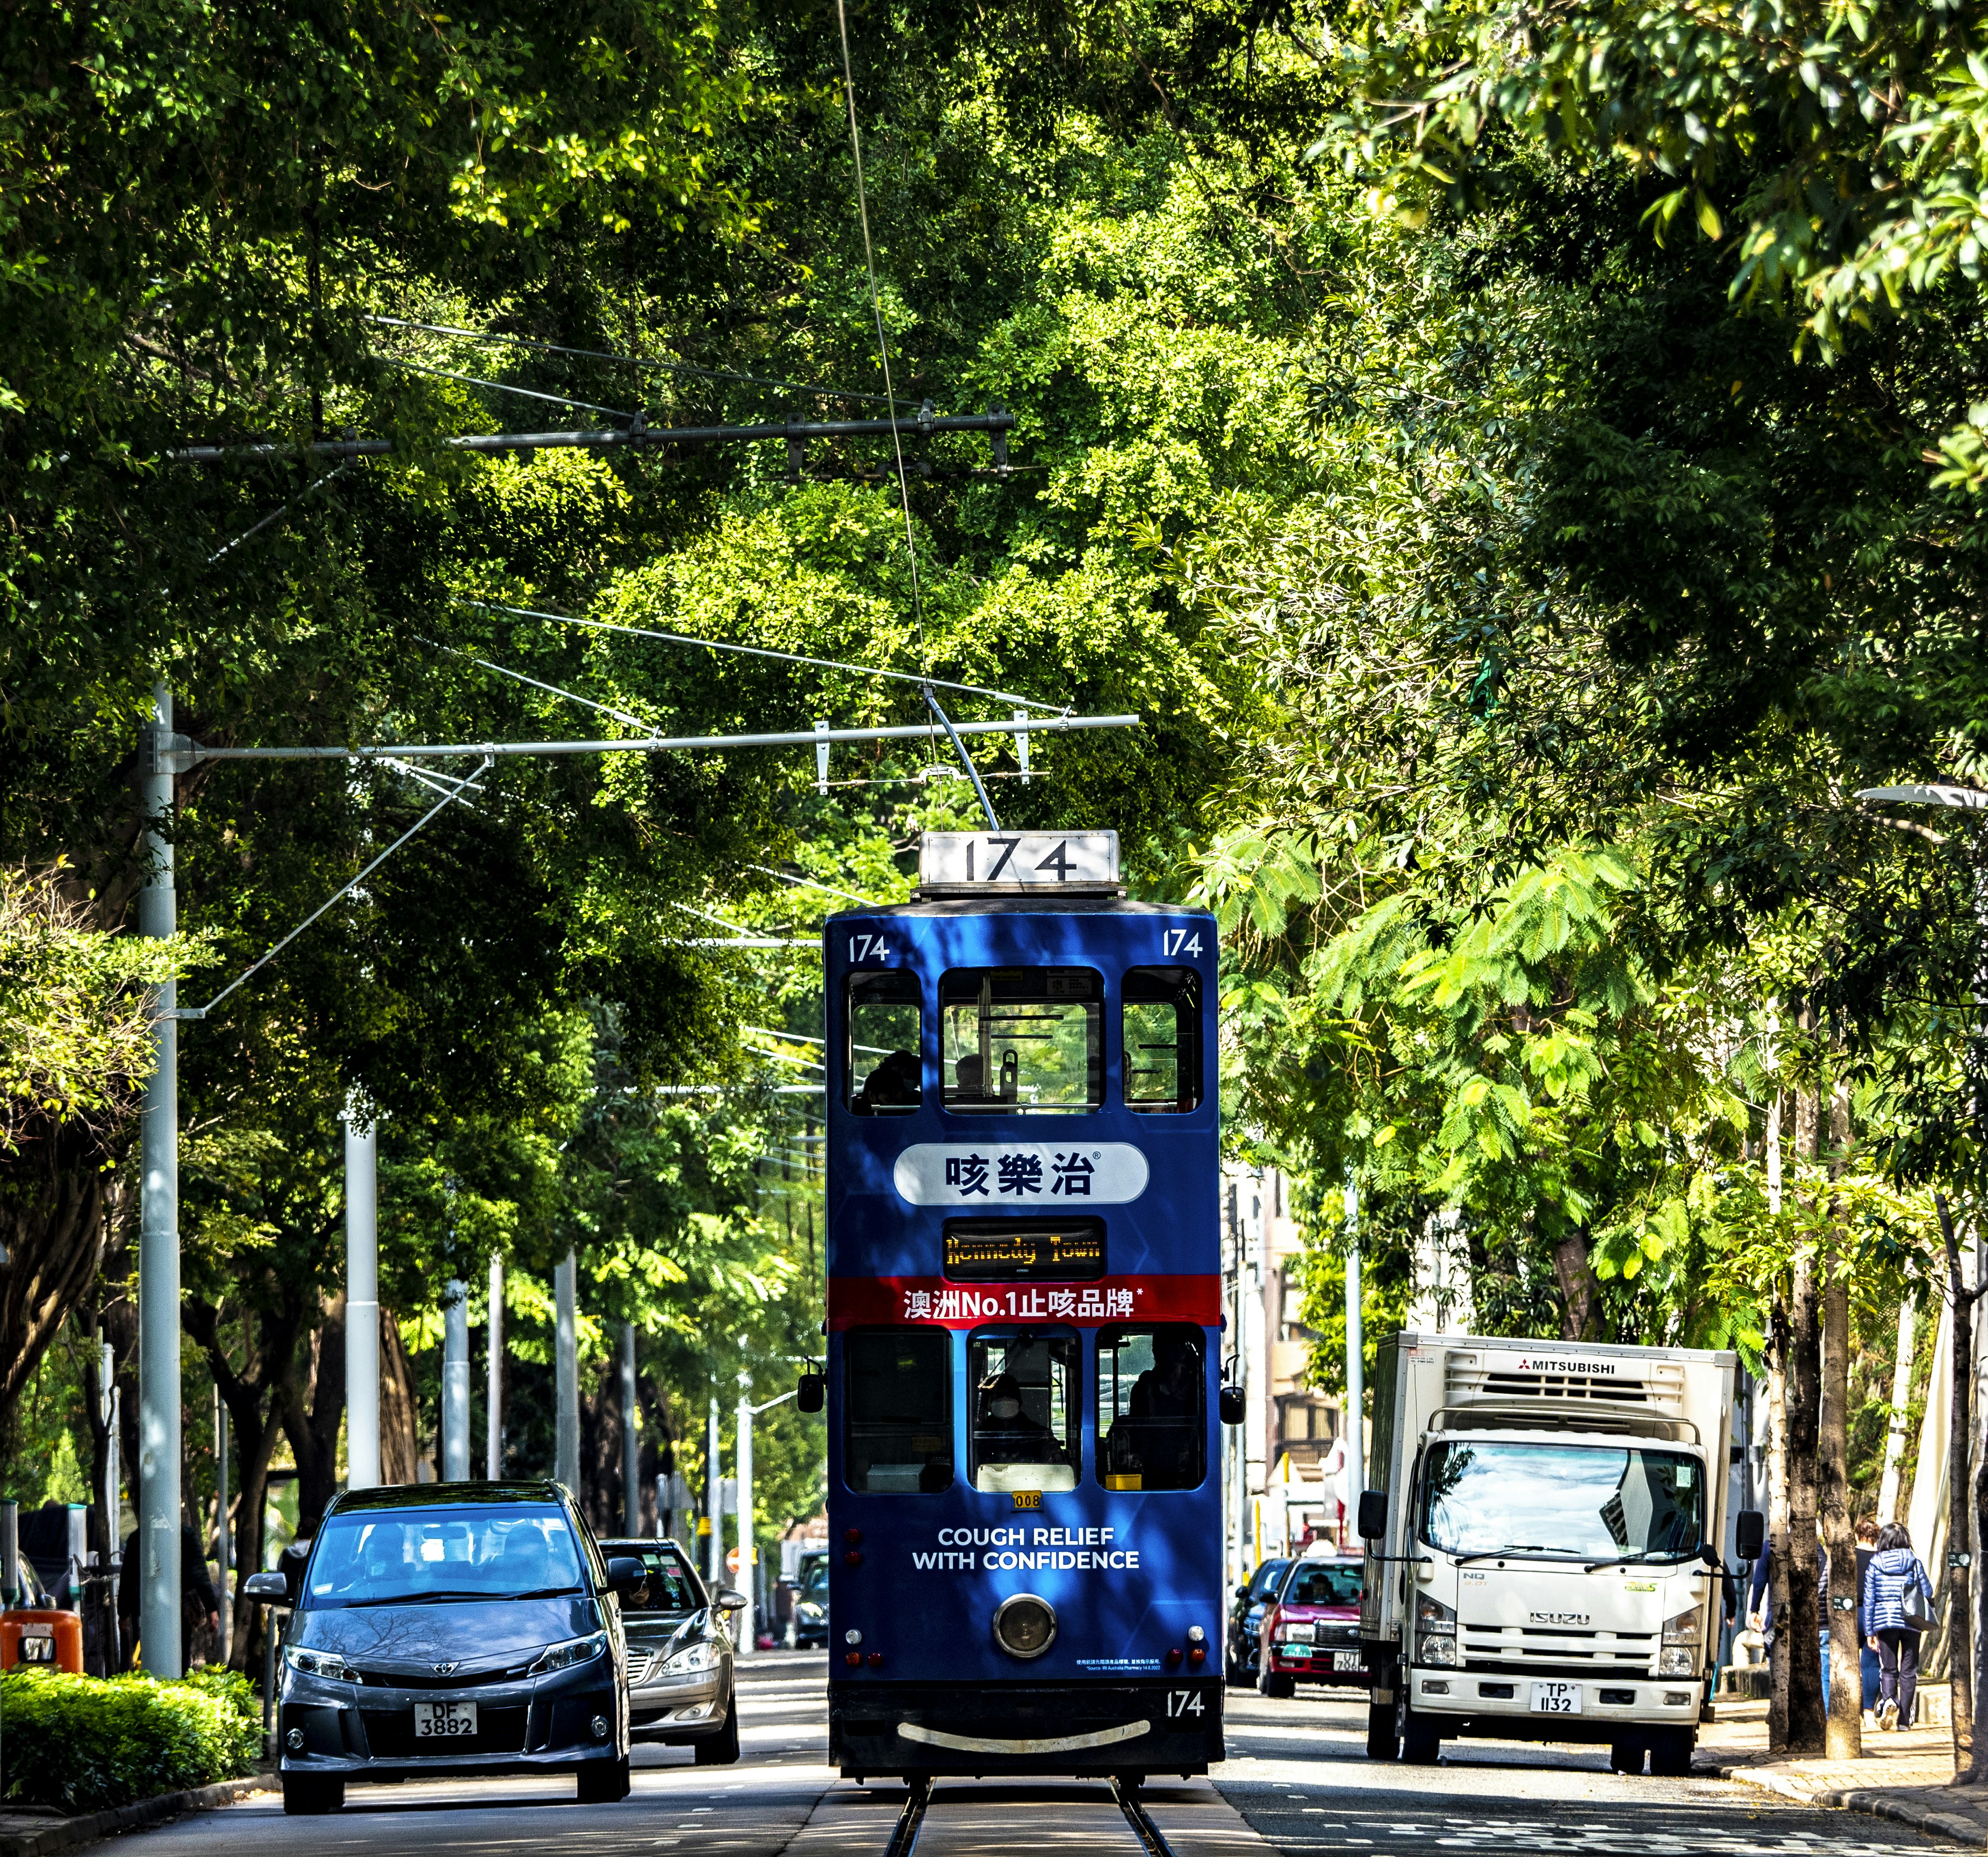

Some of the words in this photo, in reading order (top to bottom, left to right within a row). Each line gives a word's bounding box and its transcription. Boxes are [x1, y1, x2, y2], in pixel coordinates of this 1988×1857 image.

[967, 838, 1077, 881] 174
[850, 935, 890, 962] 174
[1164, 929, 1203, 958] 174
[946, 1237, 1036, 1264] Kennedy
[1050, 1236, 1100, 1262] Town
[1532, 1361, 1615, 1374] MITSUBISHI
[1015, 1494, 1040, 1507] 008
[938, 1528, 1024, 1546] COUGH
[1034, 1528, 1114, 1545] RELIEF
[913, 1552, 974, 1570] WITH
[983, 1551, 1139, 1570] CONFIDENCE
[1530, 1610, 1590, 1625] ISUZU
[1337, 1660, 1365, 1670] 706
[1546, 1683, 1567, 1696] TP
[432, 1703, 459, 1719] DF
[1167, 1690, 1205, 1717] 174
[1541, 1697, 1571, 1711] 1132
[421, 1718, 472, 1736] 3882
